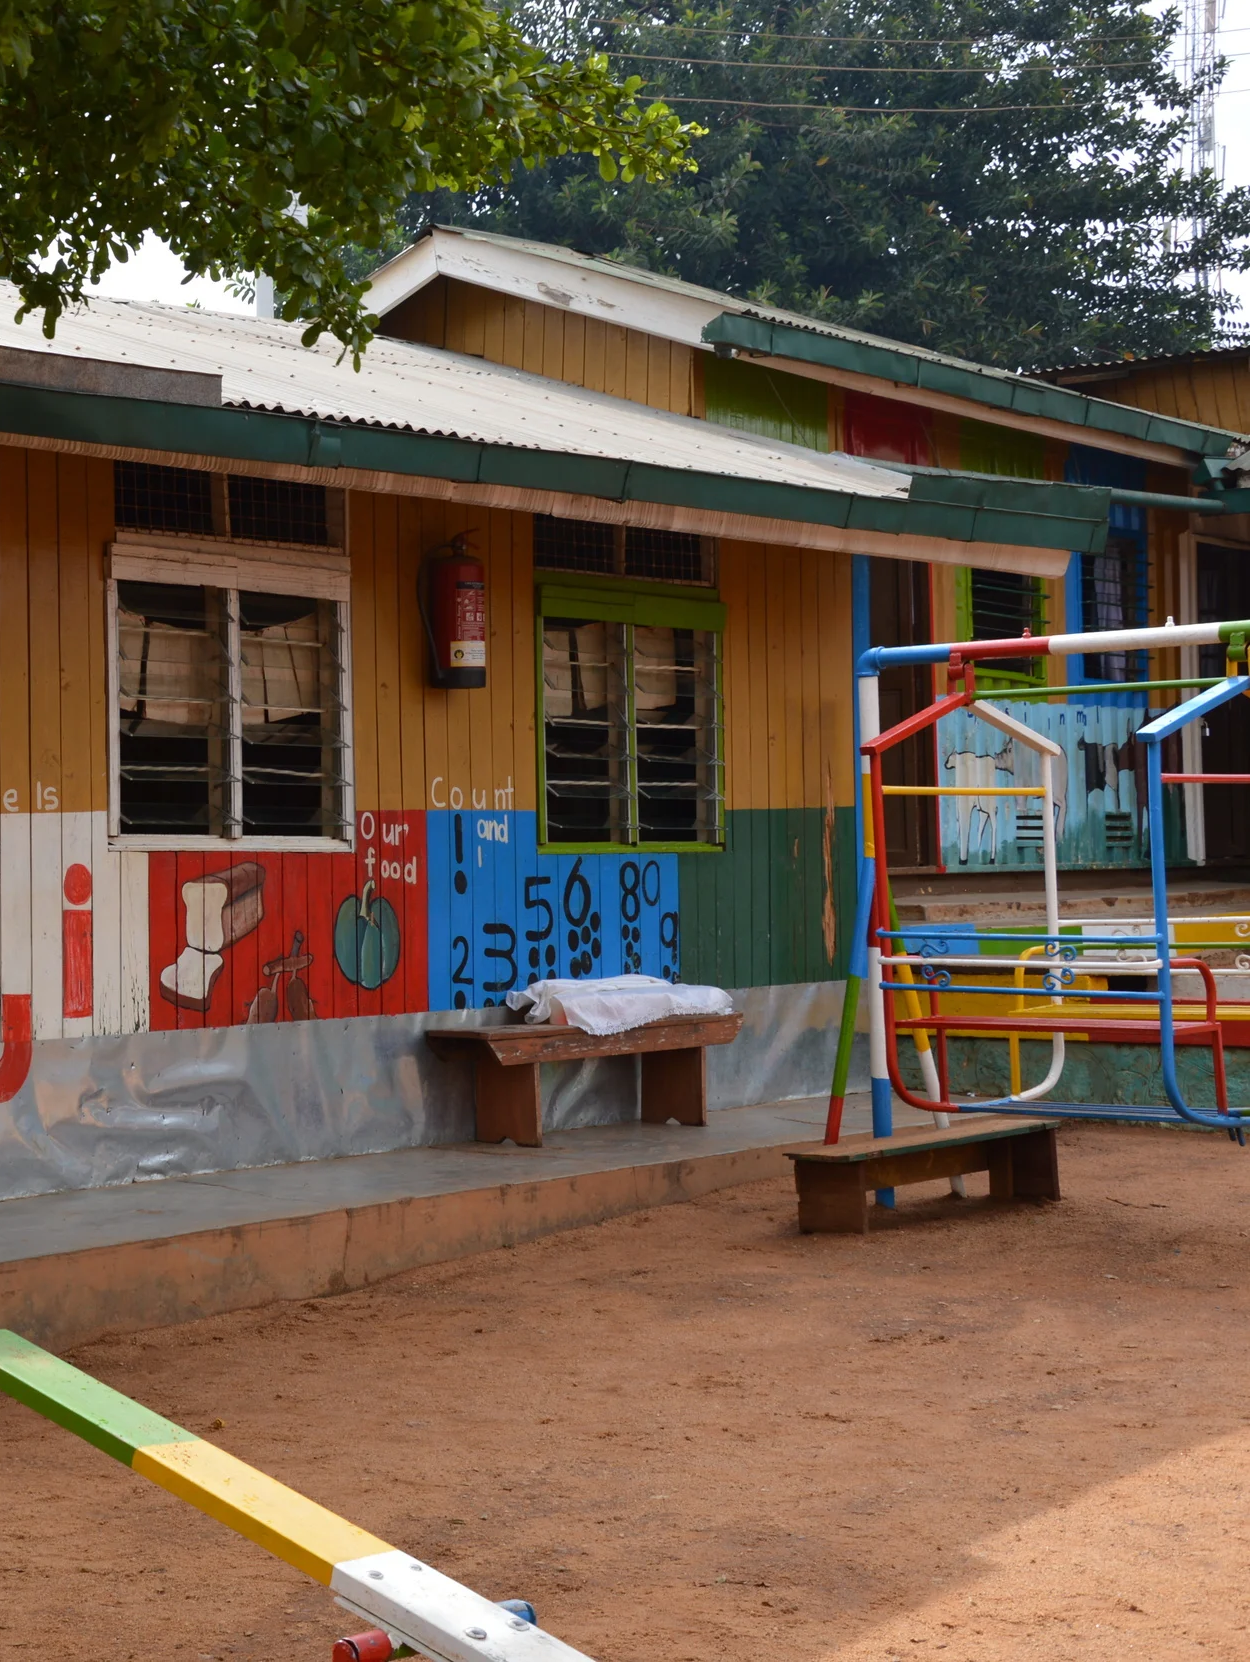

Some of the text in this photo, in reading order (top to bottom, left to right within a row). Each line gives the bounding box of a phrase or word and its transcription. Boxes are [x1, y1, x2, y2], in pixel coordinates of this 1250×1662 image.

[431, 776, 514, 810] Count
[361, 811, 410, 846] Our
[477, 814, 508, 844] and
[365, 847, 417, 885] food
